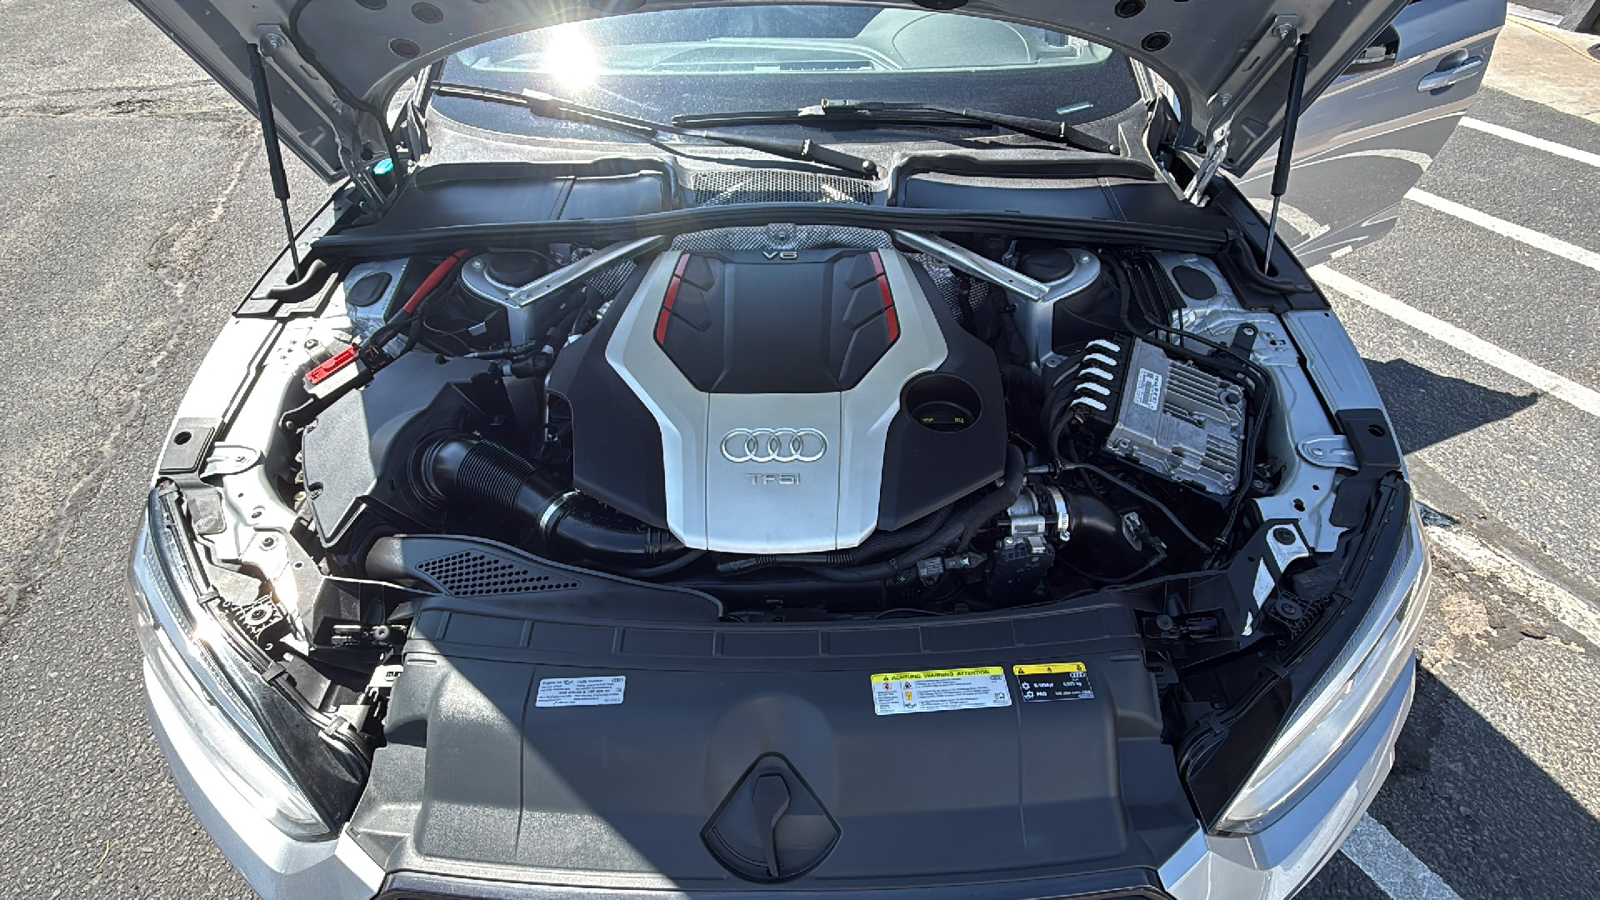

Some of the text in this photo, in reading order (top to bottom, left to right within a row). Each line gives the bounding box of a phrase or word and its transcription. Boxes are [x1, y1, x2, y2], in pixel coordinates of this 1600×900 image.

[762, 251, 798, 260] V6
[746, 473, 801, 485] TFSI
[891, 669, 990, 681] ACHTUNG WARNING ATTENTION
